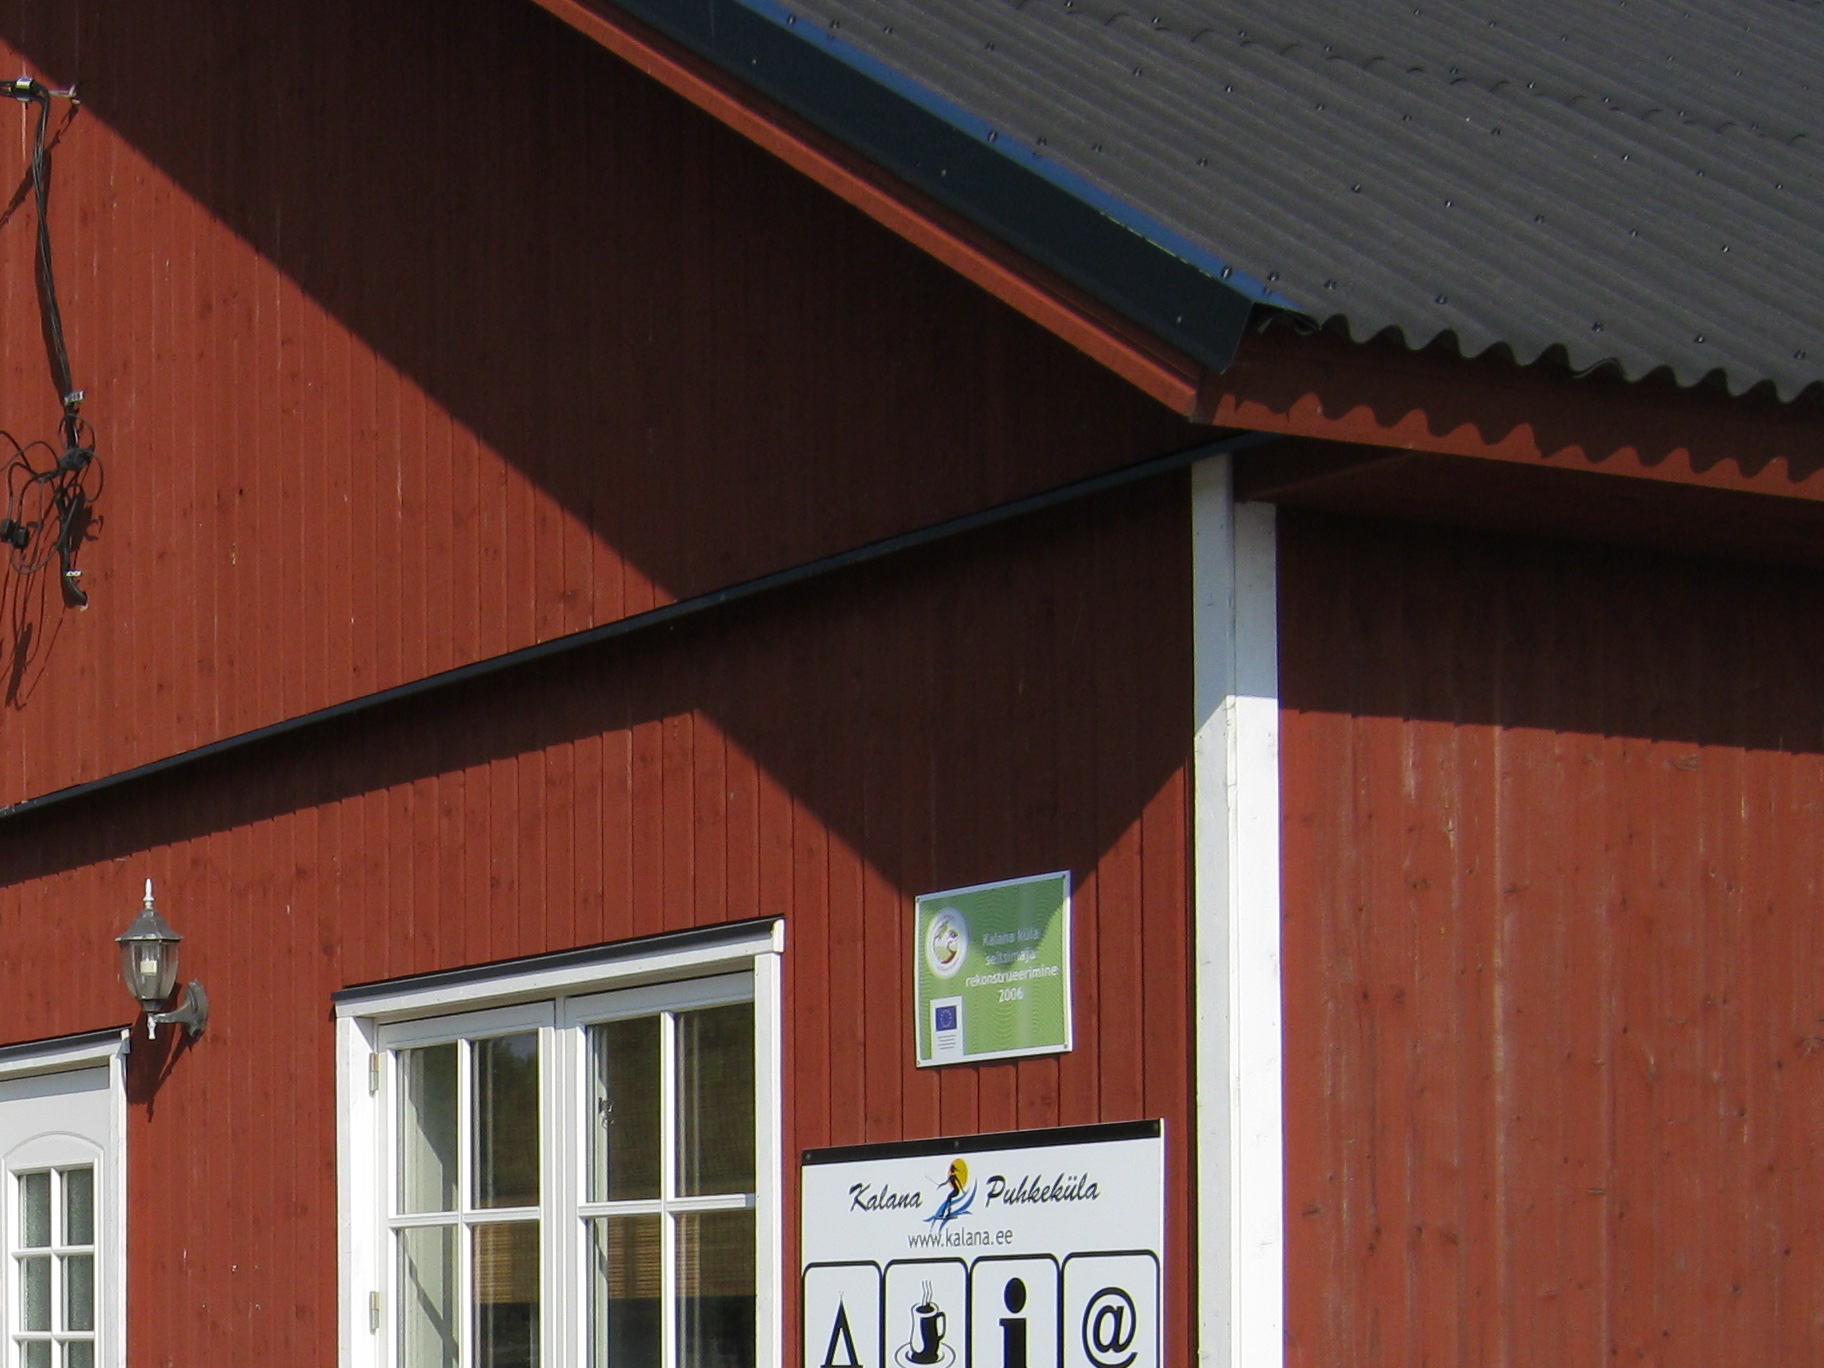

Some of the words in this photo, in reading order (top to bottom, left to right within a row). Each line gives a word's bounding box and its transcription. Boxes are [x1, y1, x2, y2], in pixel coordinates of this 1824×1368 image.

[965, 965, 1059, 987] rekonstrueerimine
[998, 987, 1024, 1003] 2006
[848, 1183, 923, 1211] Kalana
[985, 1171, 1100, 1208] Puhkeküla
[908, 1227, 1014, 1249] www.kalana.ee
